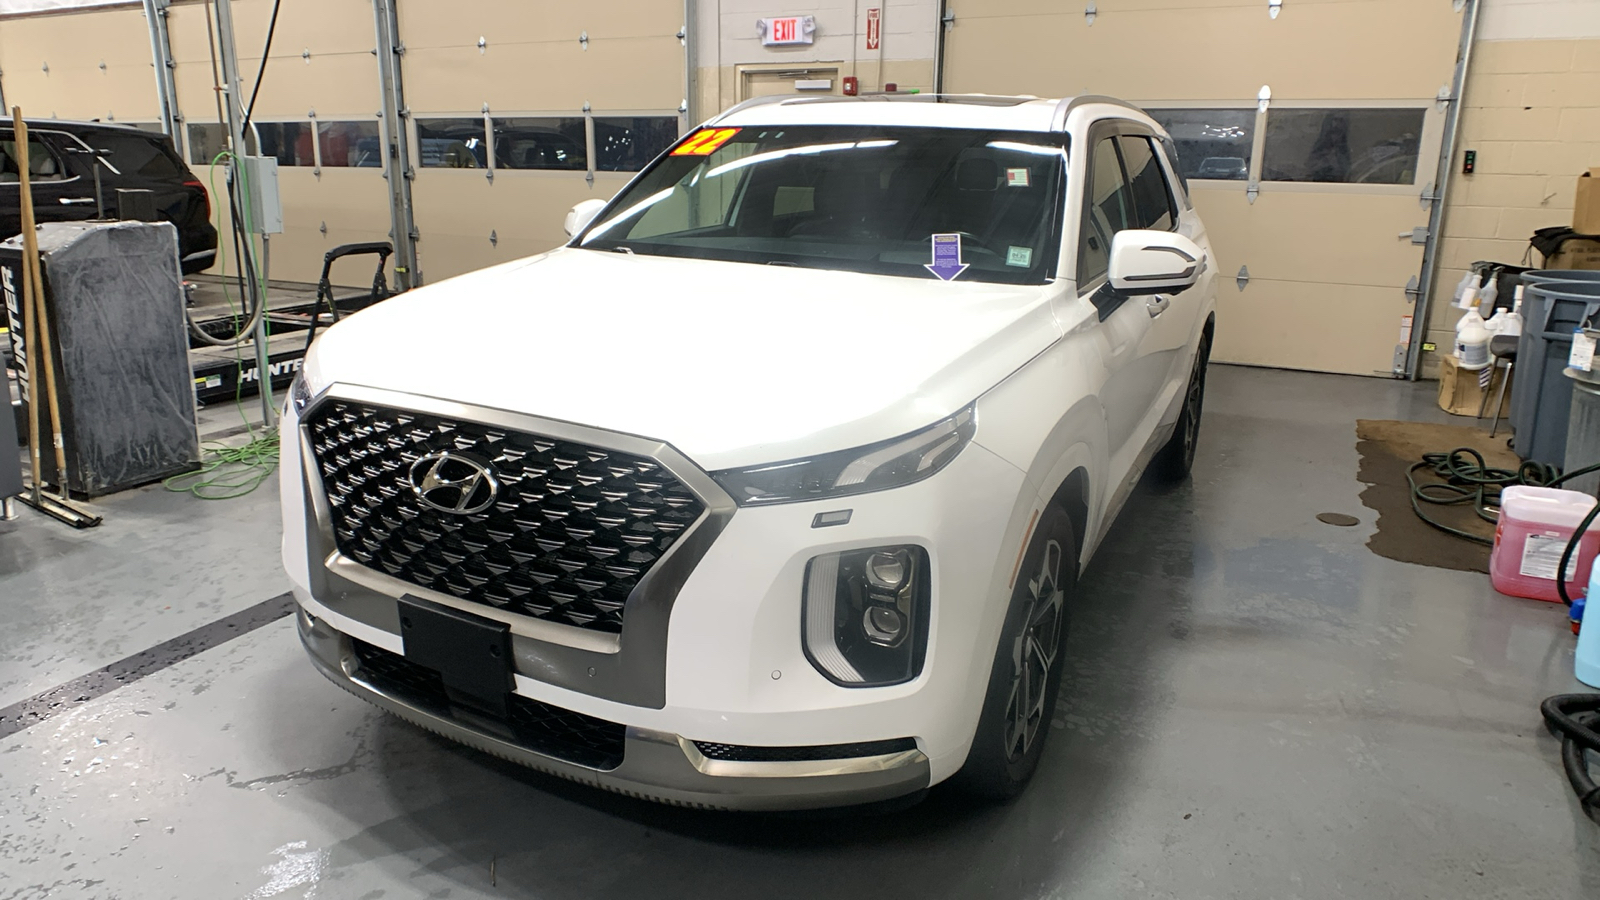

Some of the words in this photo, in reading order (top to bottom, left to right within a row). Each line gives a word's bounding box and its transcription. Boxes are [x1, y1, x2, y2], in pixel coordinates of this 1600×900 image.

[773, 19, 797, 42] EXIT
[674, 129, 736, 154] 22
[1, 265, 30, 403] HUNTER
